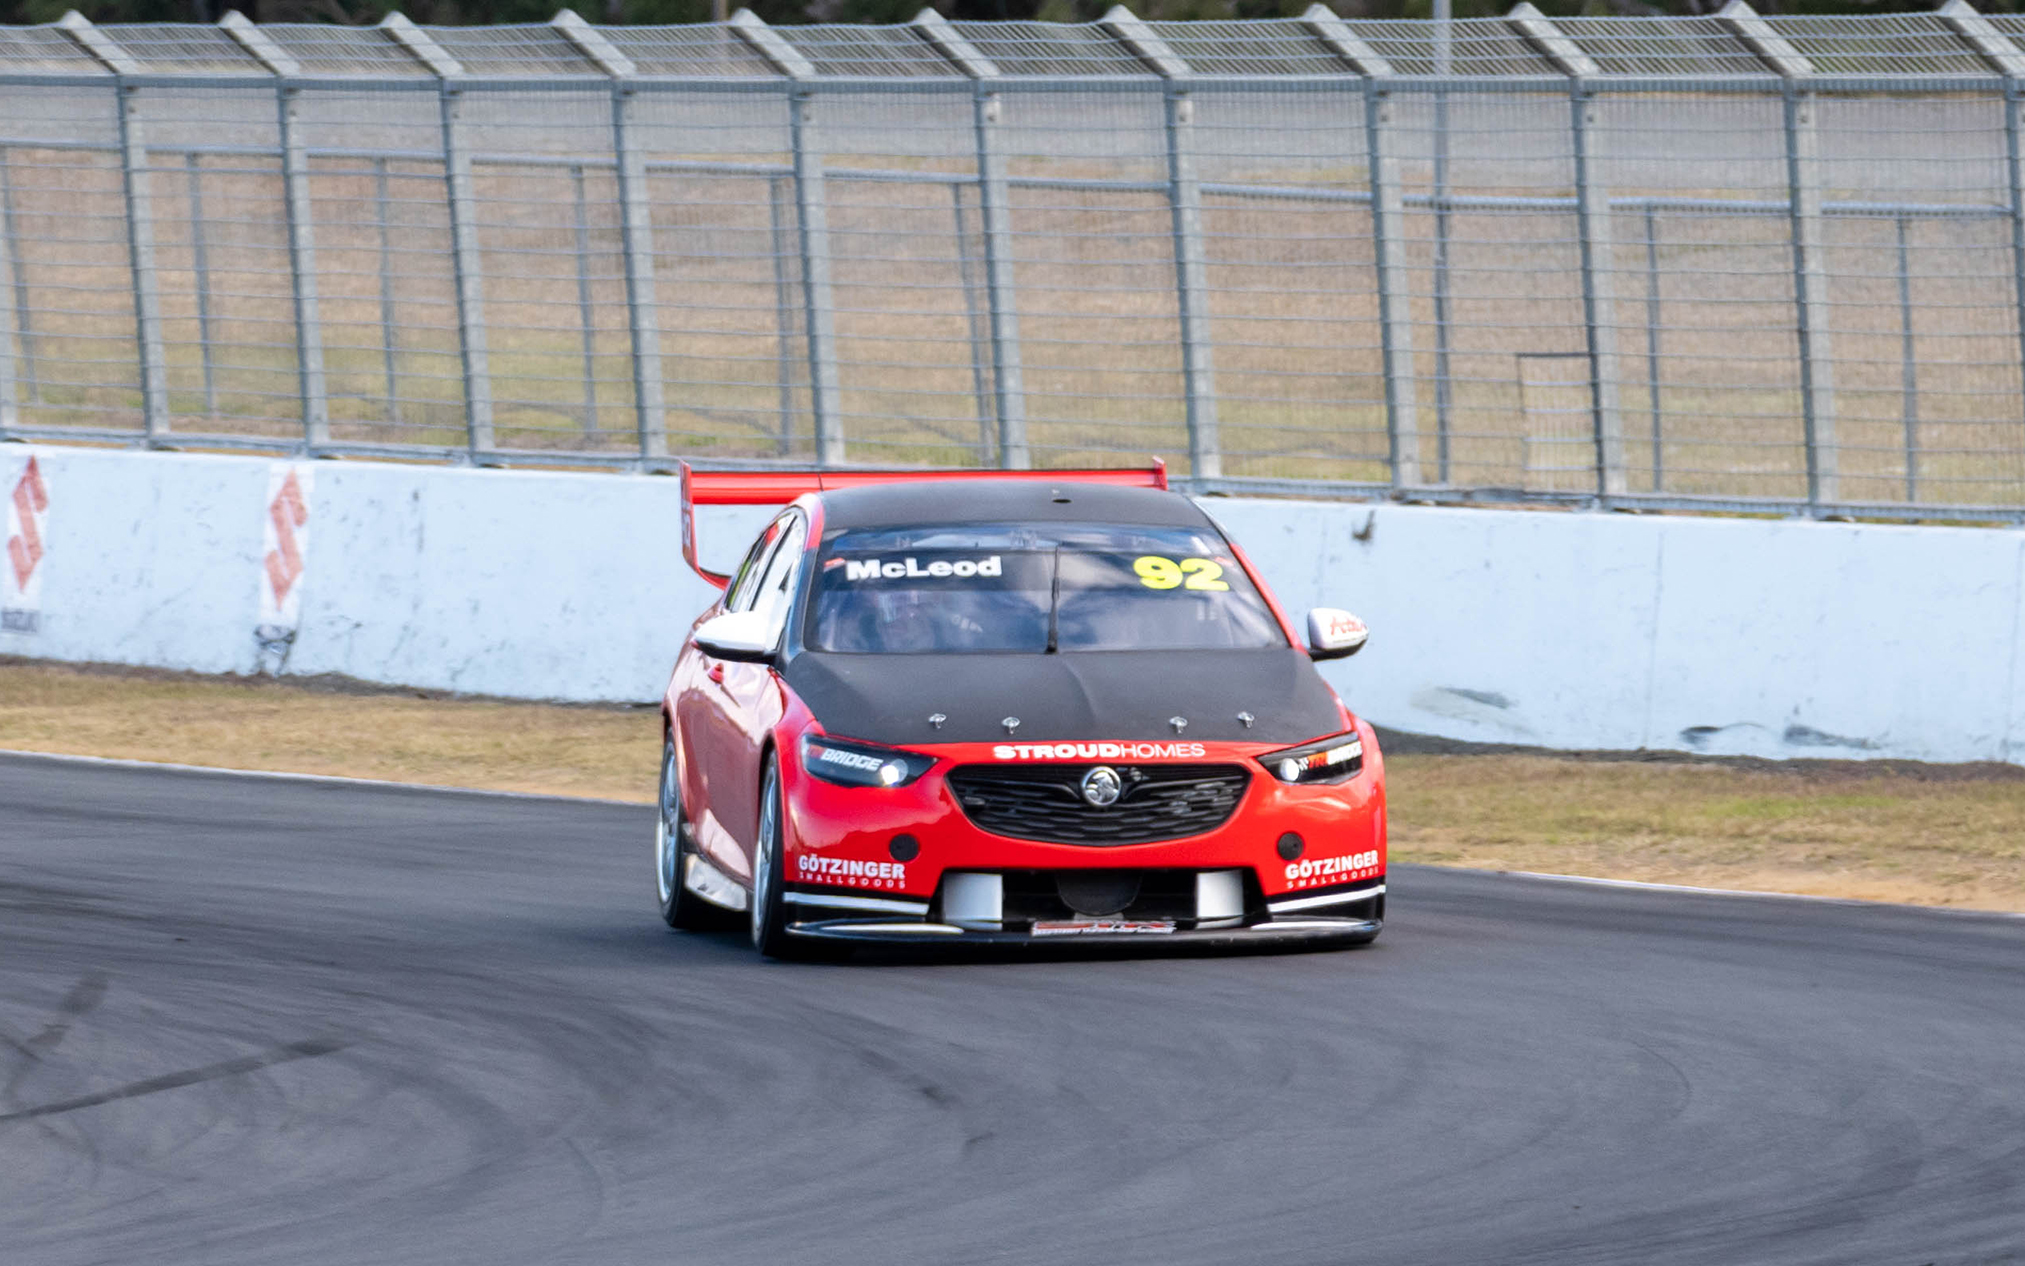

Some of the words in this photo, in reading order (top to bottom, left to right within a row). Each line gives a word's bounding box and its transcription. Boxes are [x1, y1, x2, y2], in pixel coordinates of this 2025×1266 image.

[846, 556, 1002, 580] McLeod
[1133, 556, 1229, 591] 92
[799, 853, 905, 879] GÖTZINGER
[1285, 850, 1378, 880] GÖTZINGER
[799, 872, 905, 889] SMALLGOODS
[1286, 867, 1378, 889] SMALLGOODS
